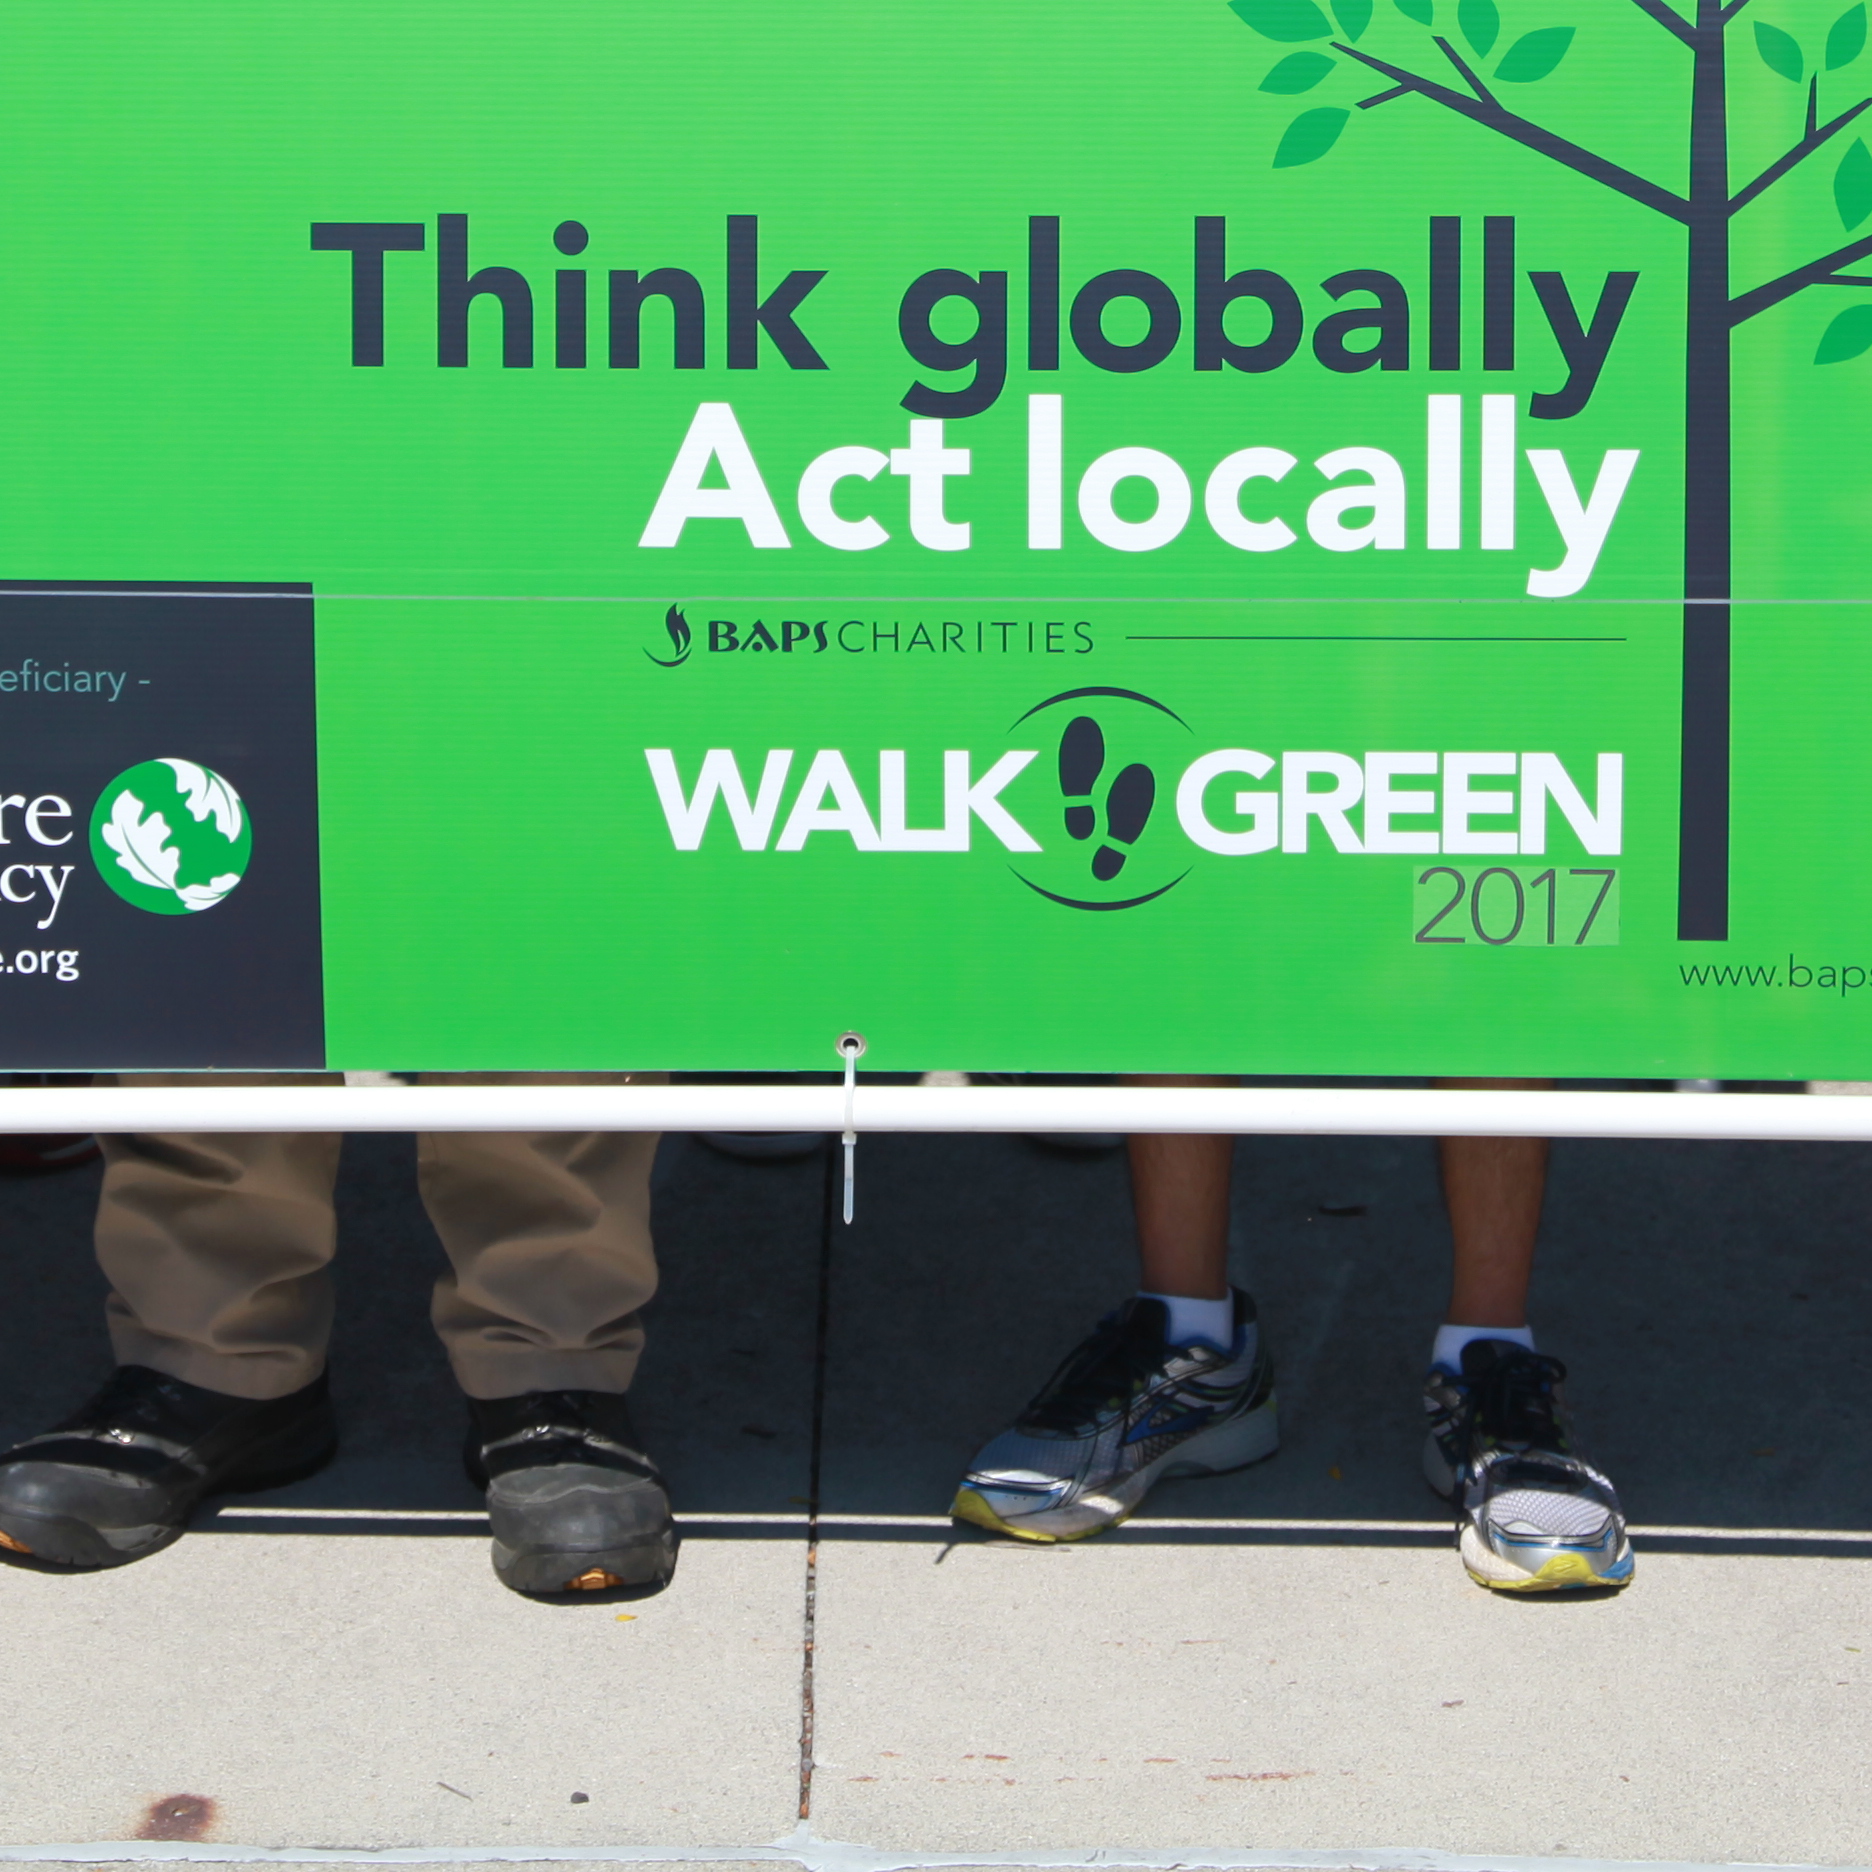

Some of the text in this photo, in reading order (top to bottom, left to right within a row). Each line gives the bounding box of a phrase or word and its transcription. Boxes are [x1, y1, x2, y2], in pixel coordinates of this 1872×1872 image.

[310, 212, 1641, 420] Think globally
[638, 393, 1641, 598] Act locally
[642, 747, 1622, 857] WALK GREEN
[1413, 866, 1617, 947] 2017
